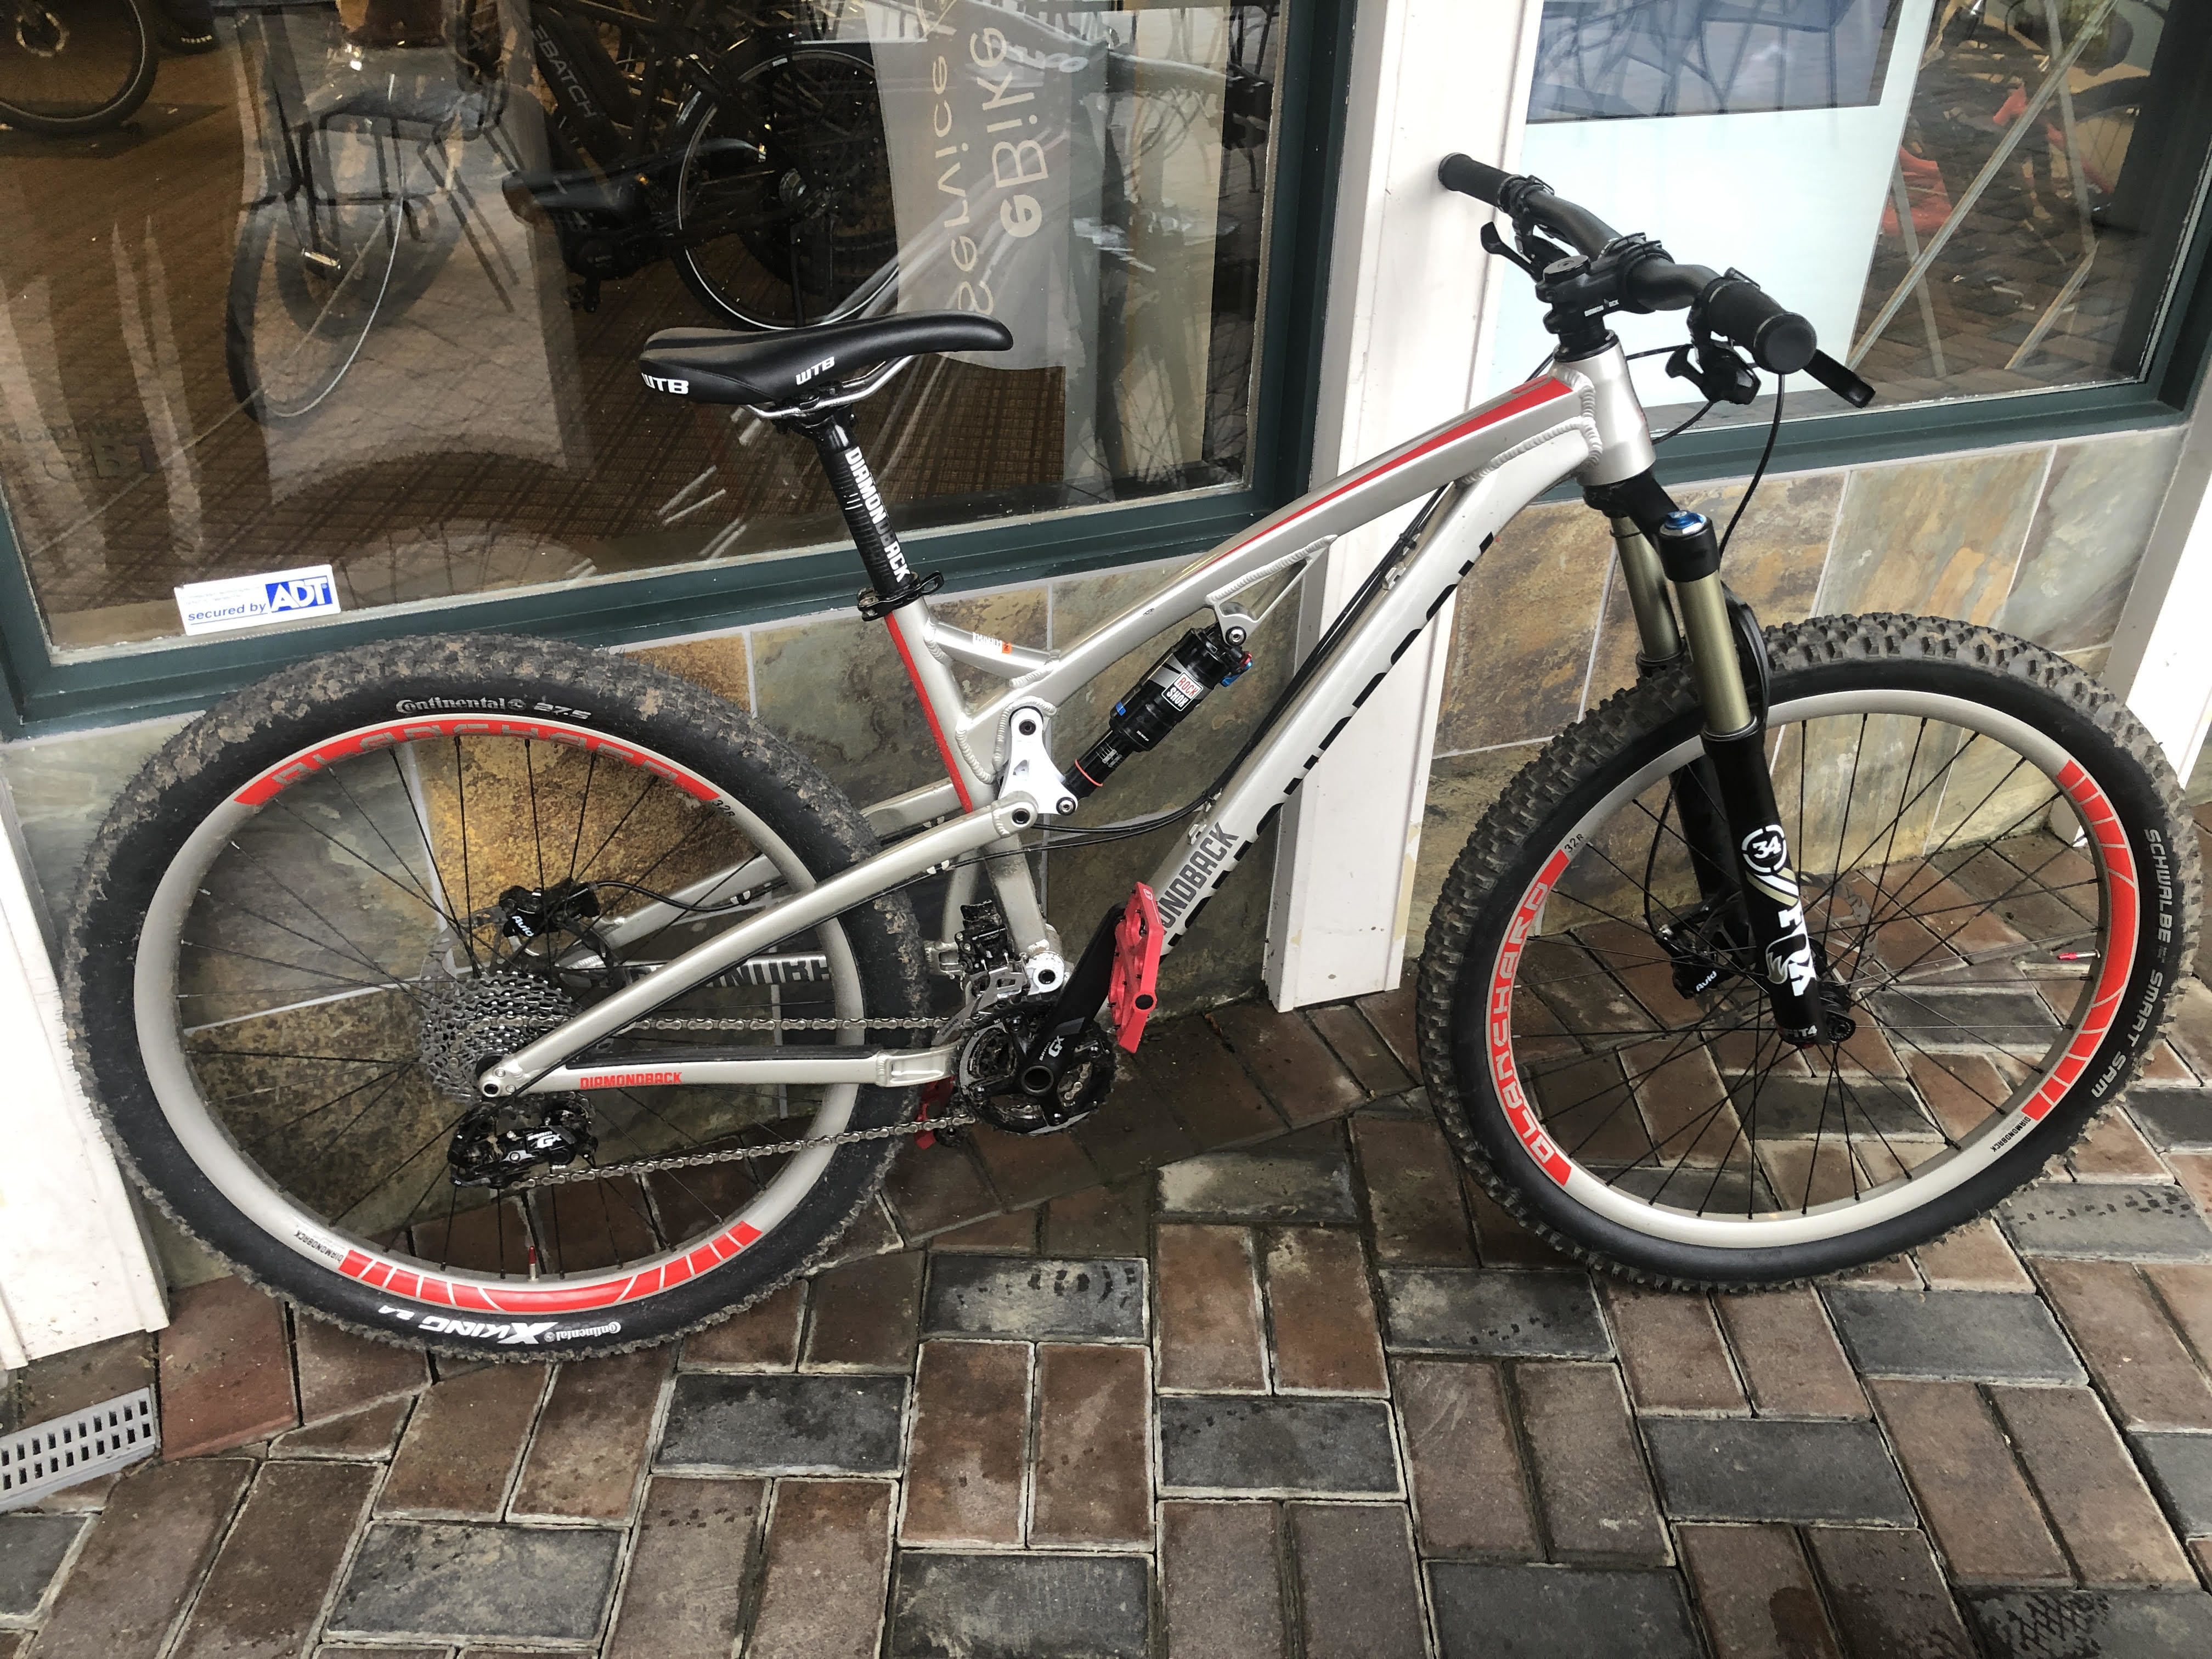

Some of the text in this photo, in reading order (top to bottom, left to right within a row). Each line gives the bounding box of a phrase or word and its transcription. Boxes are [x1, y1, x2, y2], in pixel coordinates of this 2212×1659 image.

[539, 40, 597, 118] BATCH
[795, 356, 835, 385] WTB
[641, 373, 689, 394] WTB
[845, 446, 911, 583] DIAMONDBACK
[188, 604, 245, 620] secured
[250, 602, 267, 613] by
[270, 577, 328, 609] ADT
[1166, 687, 1189, 708] SHOX
[1177, 677, 1198, 697] ROCK
[396, 697, 592, 720] Continental 27.5
[1564, 833, 1584, 853] 32R
[1752, 836, 1781, 859] 34
[1158, 821, 1239, 935] ONDBACK
[512, 915, 534, 937] Avid
[2091, 828, 2172, 1098] SCHWALBE SMART SAM
[1696, 970, 1717, 991] Avid
[1048, 1035, 1065, 1058] GX
[580, 1071, 682, 1090] DIAMONDBACK
[536, 1133, 562, 1149] GX
[1989, 1116, 2032, 1153] DIAMONDBACK
[294, 1229, 344, 1264] DIAMONDBACK
[556, 1321, 622, 1342] Continental
